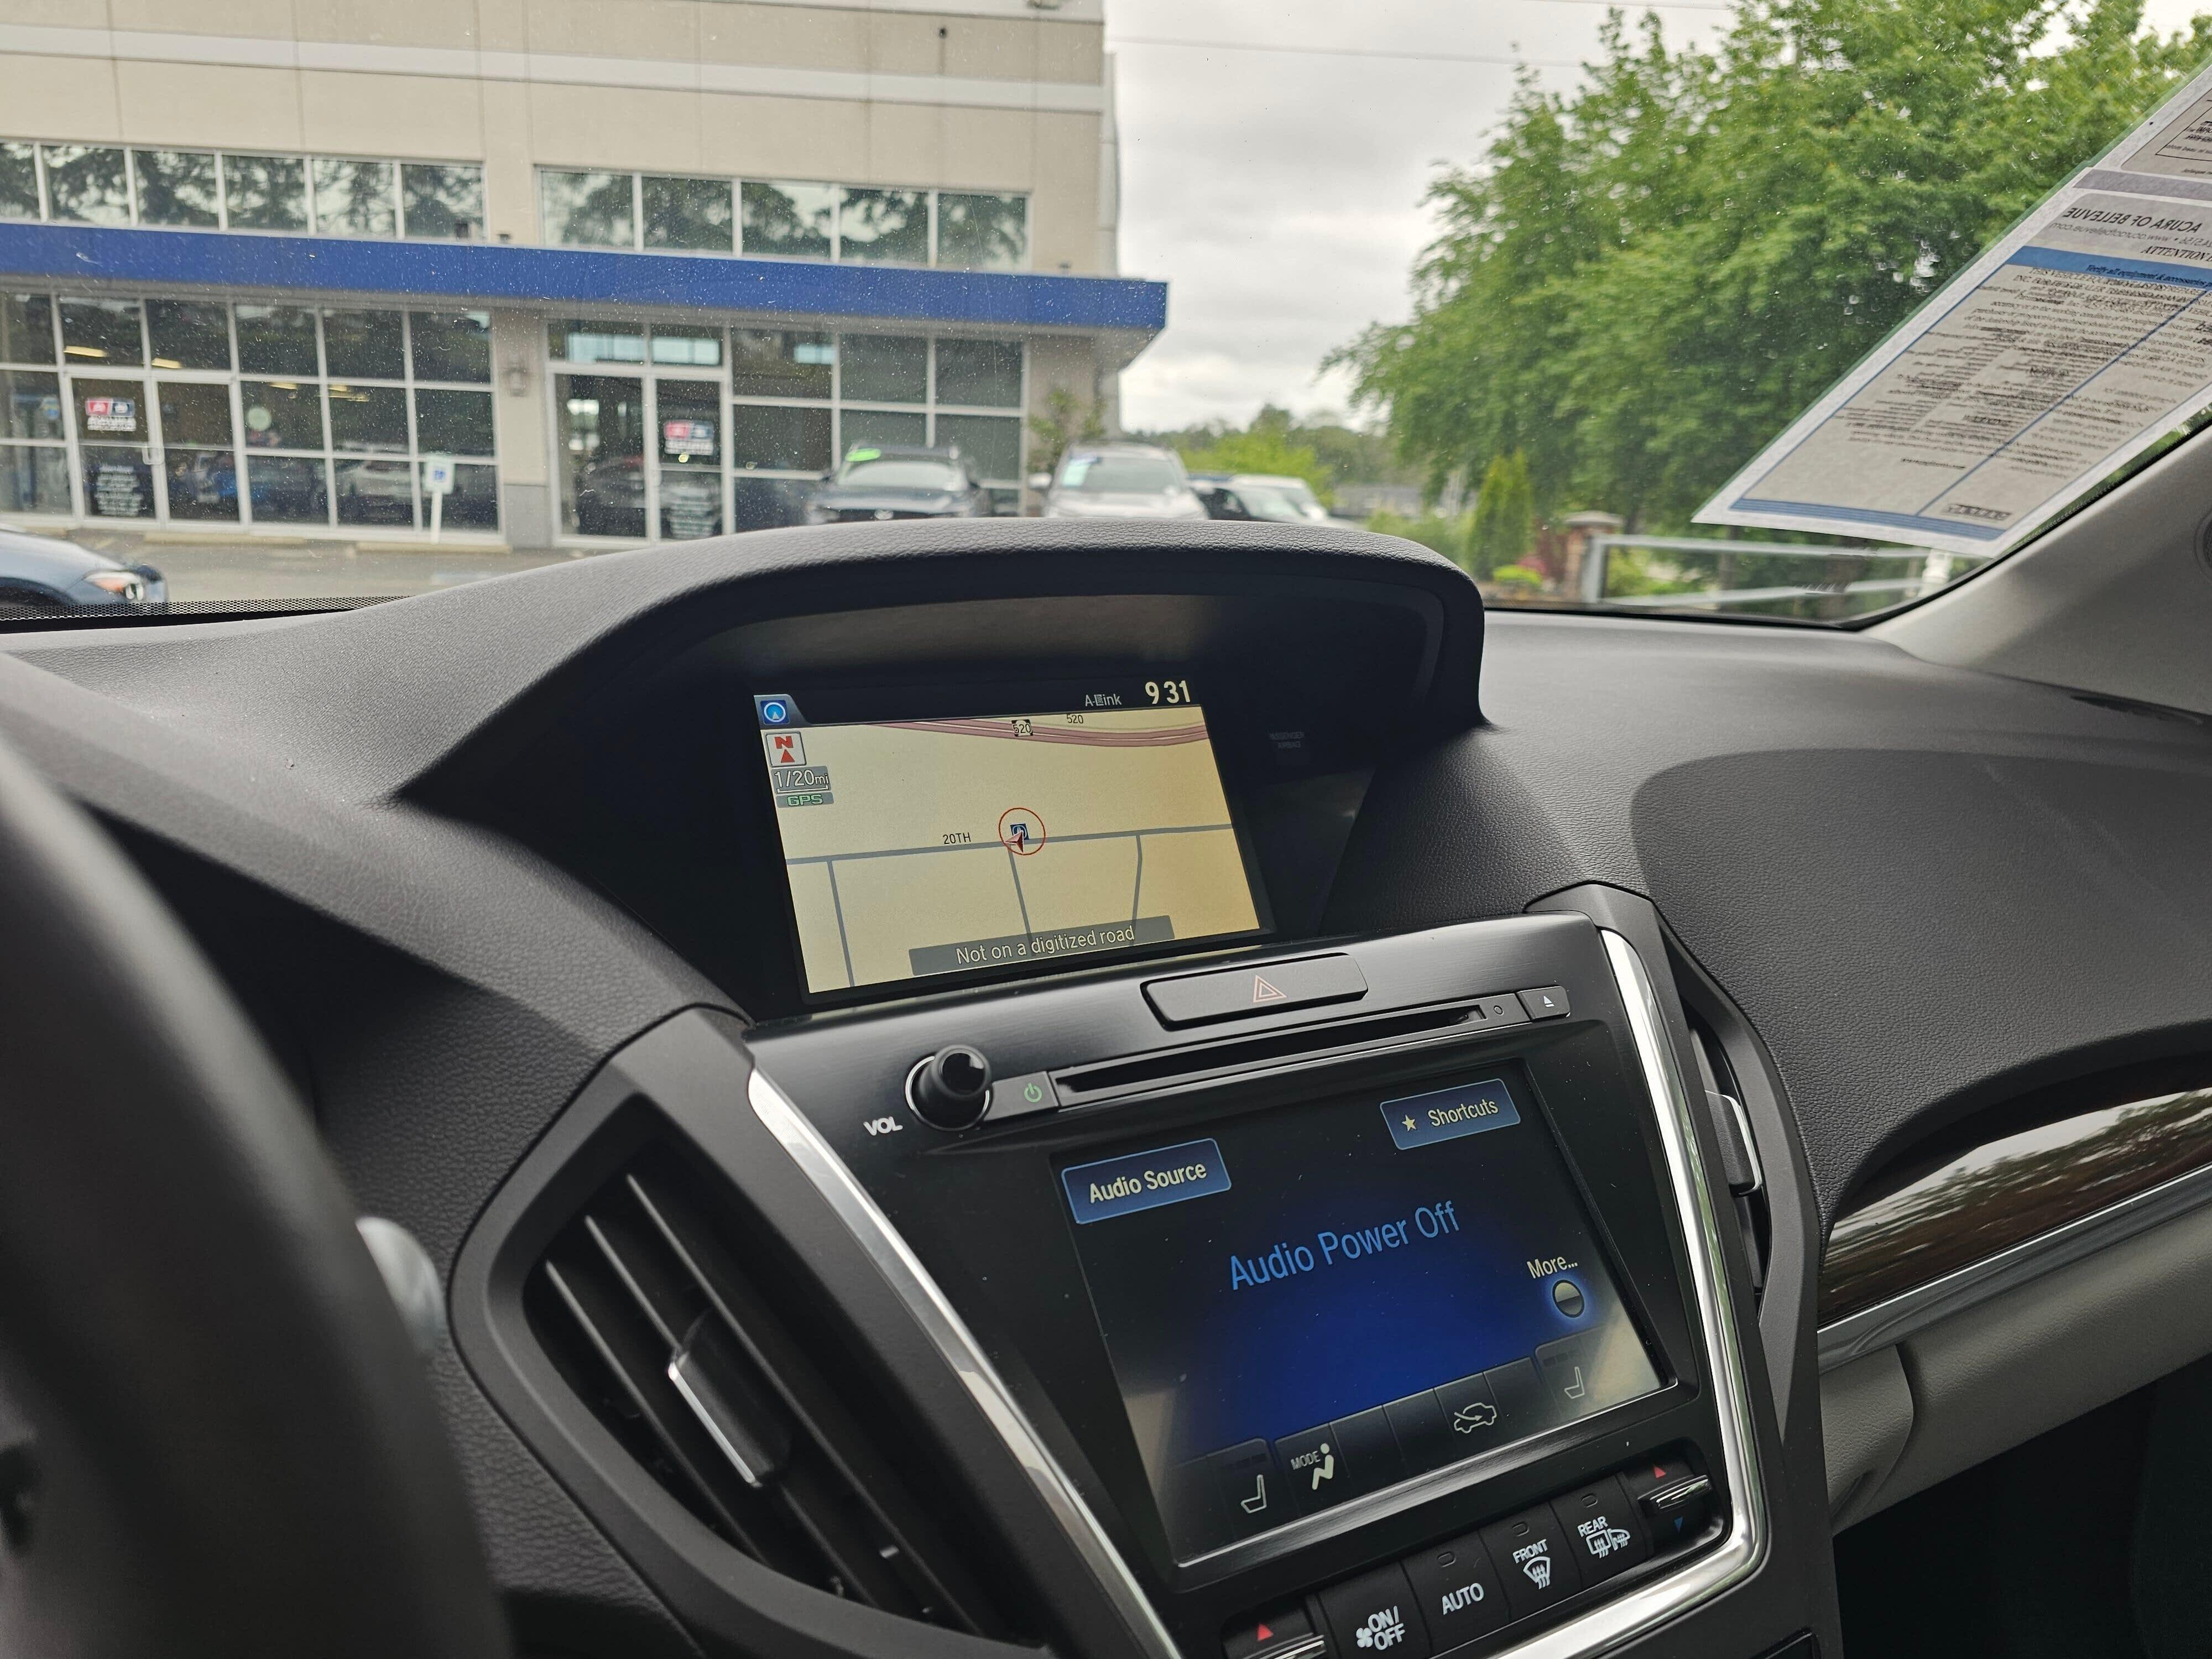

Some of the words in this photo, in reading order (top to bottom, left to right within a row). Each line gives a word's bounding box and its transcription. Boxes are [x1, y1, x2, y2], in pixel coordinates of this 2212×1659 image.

[2141, 246, 2206, 261] ATTENTION
[1013, 723, 1032, 734] 520
[1067, 714, 1084, 724] 520
[775, 736, 794, 749] N
[787, 794, 823, 806] GPS
[943, 832, 971, 845] 20TH
[956, 945, 987, 964] Not
[991, 945, 1012, 959] on
[1018, 943, 1027, 956] a
[1031, 930, 1097, 954] digitized
[1100, 925, 1135, 945] road
[1427, 1098, 1499, 1128] Shortcuts
[863, 1116, 903, 1137] VOL
[1088, 1177, 1142, 1204] Audio
[1145, 1162, 1207, 1190] Source
[1230, 1244, 1314, 1291] Audio
[1317, 1218, 1410, 1266] Power
[1414, 1200, 1459, 1239] Off
[1291, 1449, 1321, 1471] MODE
[1577, 1516, 1608, 1538] REAR
[1512, 1538, 1548, 1564] FRONT
[1441, 1582, 1485, 1616] AUTO
[1374, 1622, 1406, 1651] OFF
